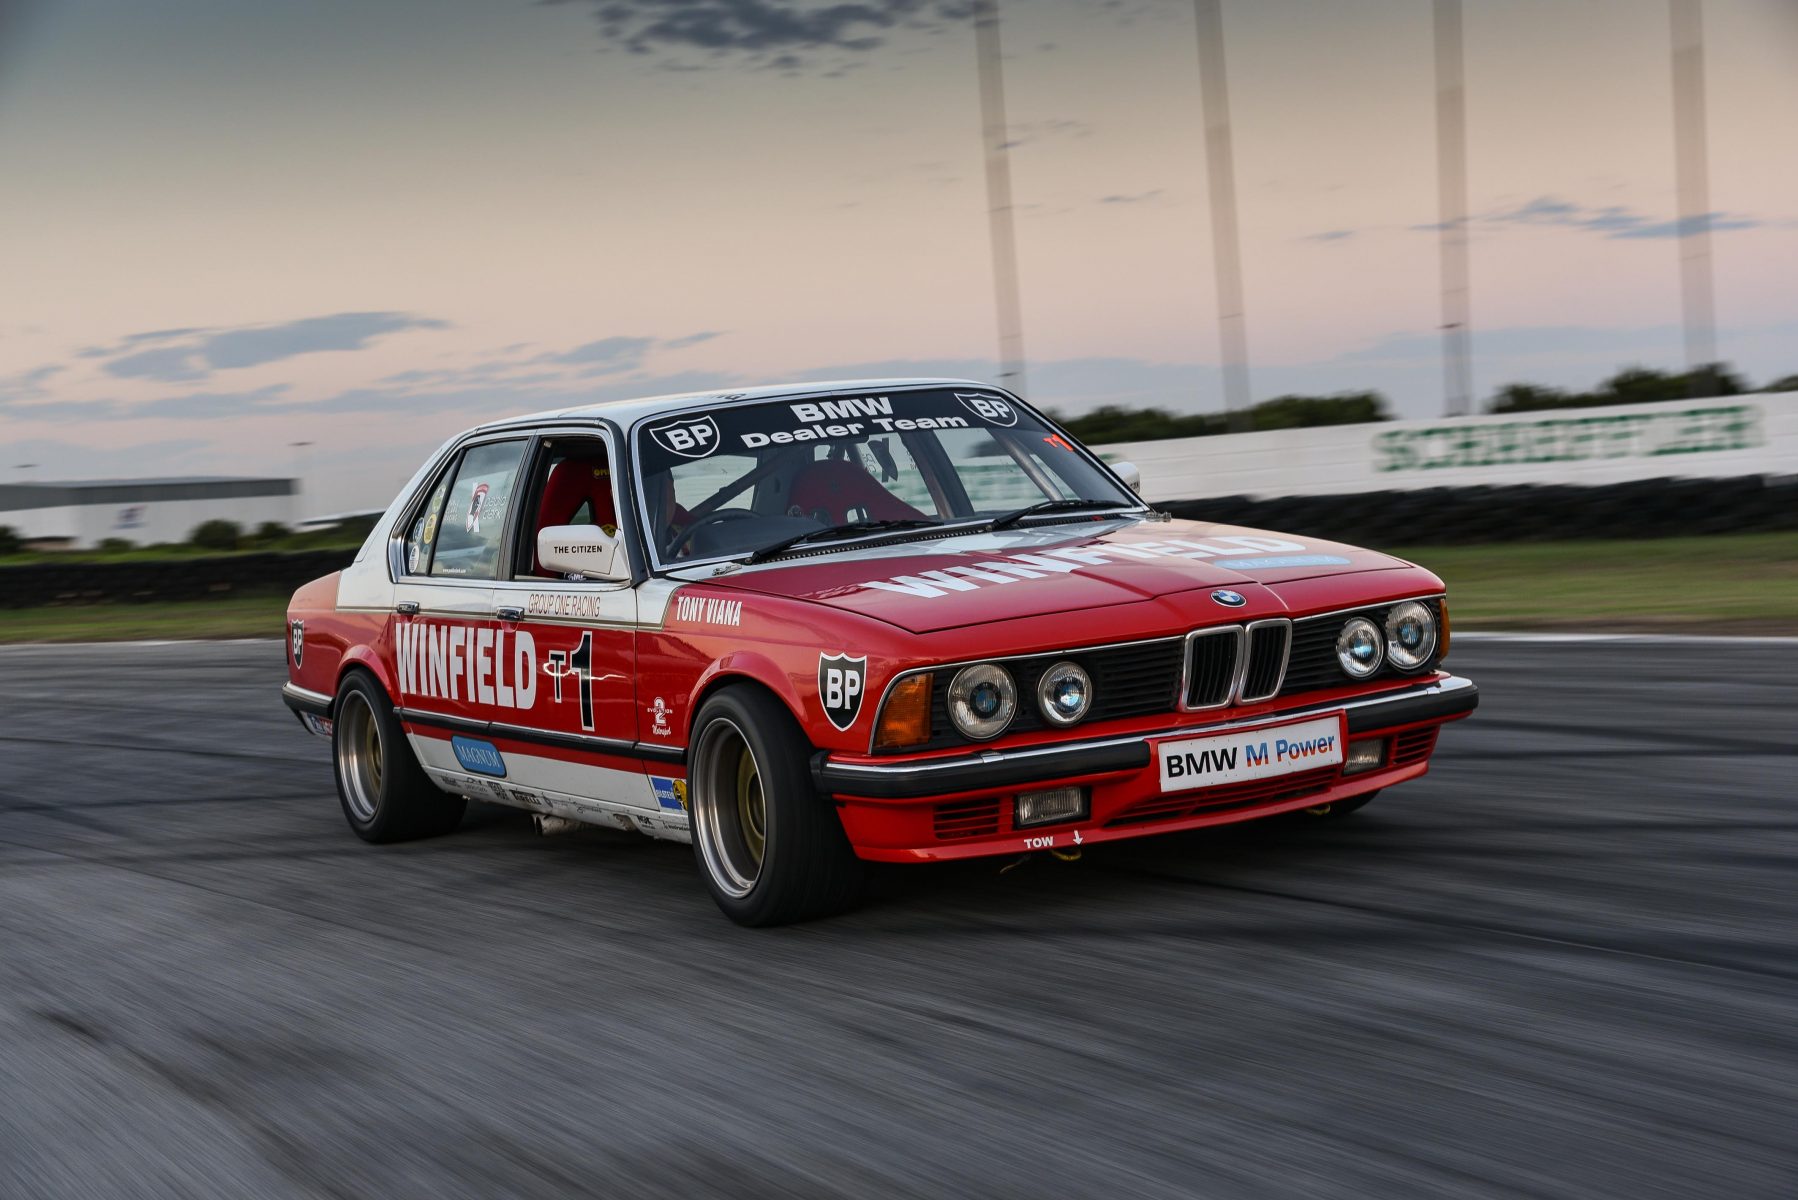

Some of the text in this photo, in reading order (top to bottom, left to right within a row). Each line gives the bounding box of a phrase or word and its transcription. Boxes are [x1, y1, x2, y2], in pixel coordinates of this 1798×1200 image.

[789, 396, 894, 423] BMW
[969, 399, 1011, 419] BP
[665, 424, 713, 451] BP
[740, 416, 969, 449] Dealer Team
[553, 545, 603, 554] THE CITIZEN
[860, 536, 1307, 599] WINFIELD
[528, 593, 601, 618] GROUP ONE RACING
[676, 596, 743, 627] TONY VIANA
[293, 628, 303, 655] BP
[395, 622, 537, 710] WINFIELD
[826, 668, 861, 710] BP
[457, 744, 500, 768] MAGNUM
[1166, 735, 1335, 778] BMW M Power
[1023, 836, 1054, 849] TOW
